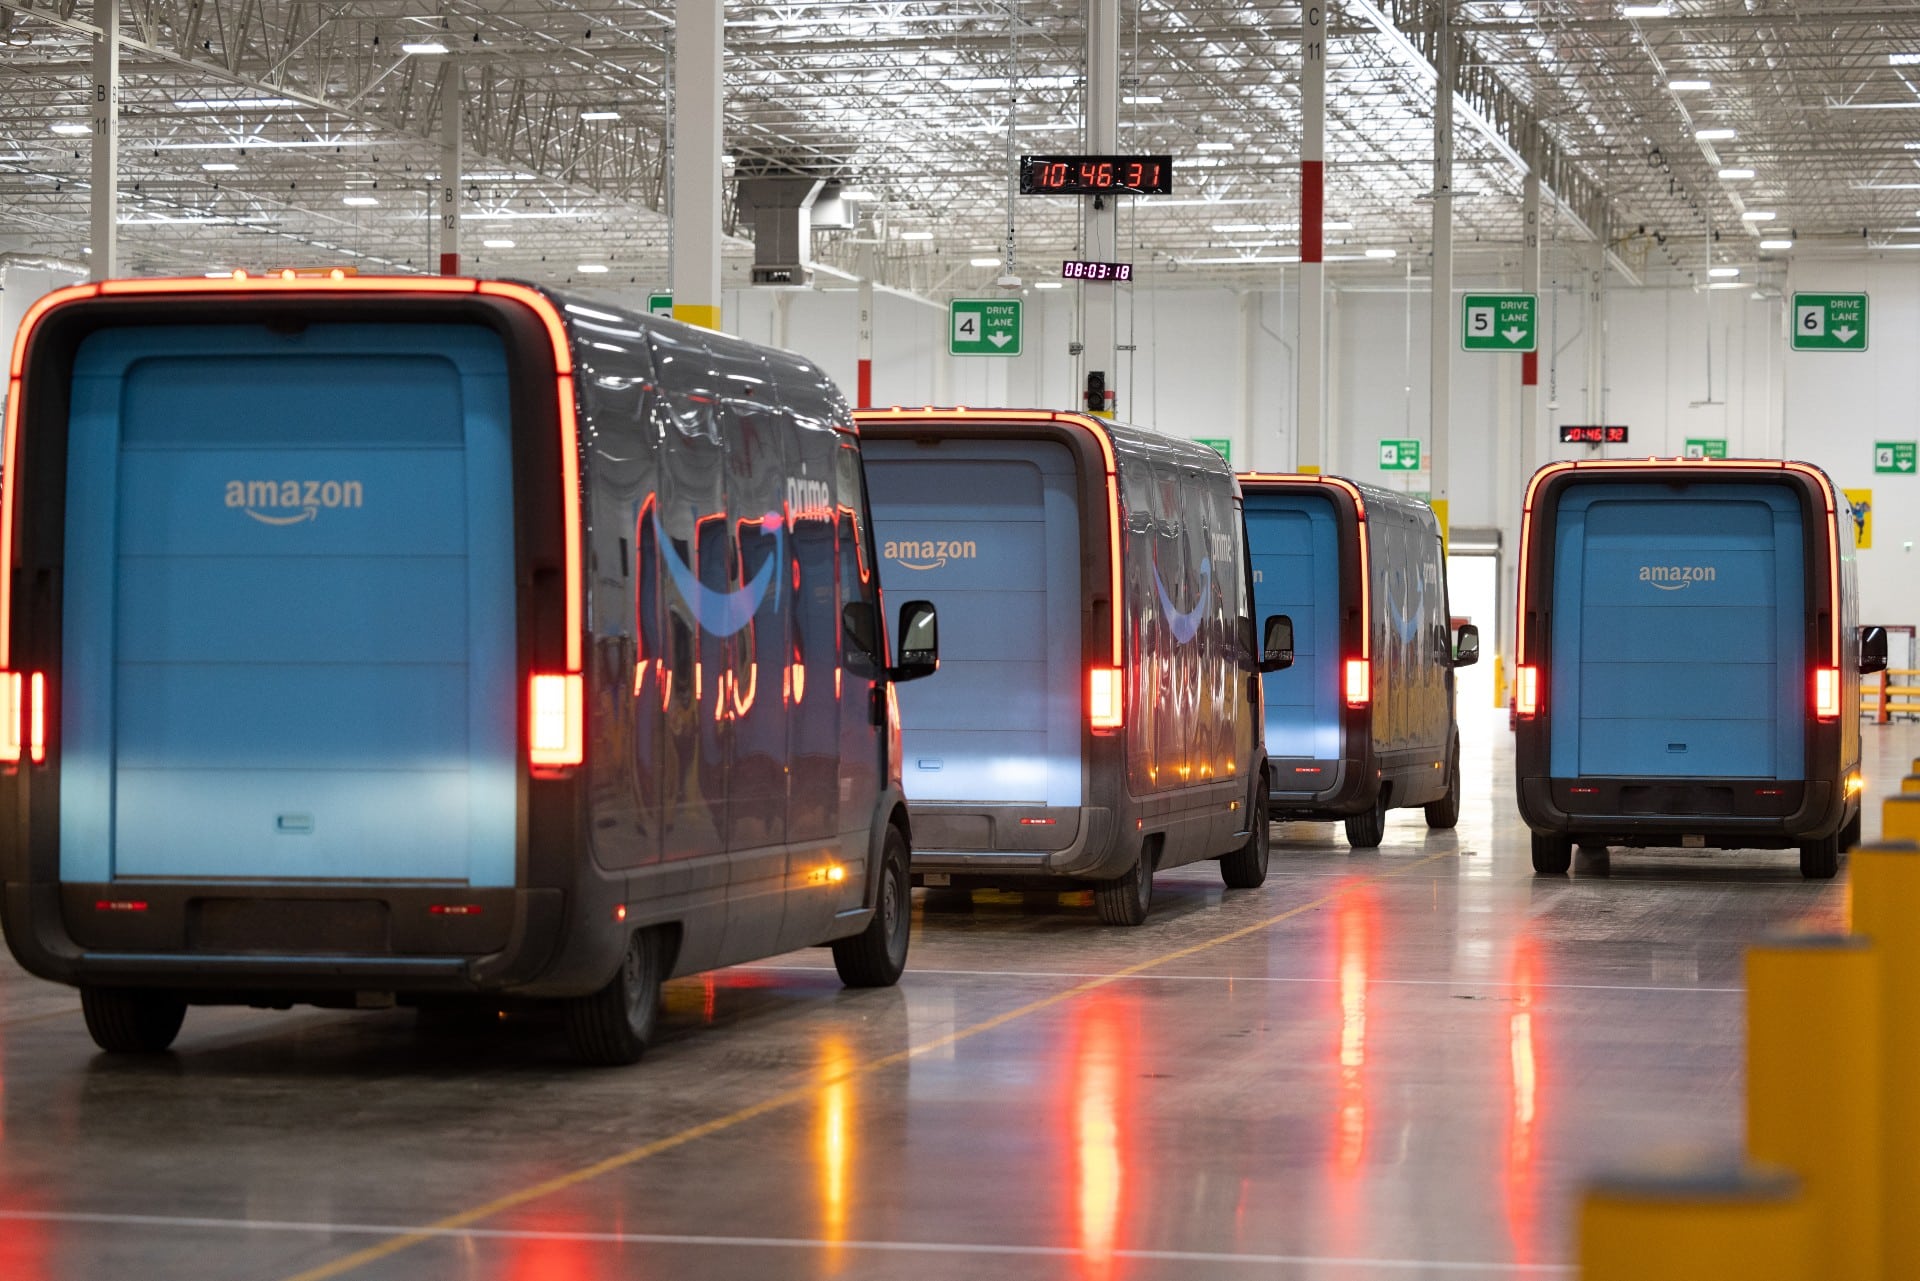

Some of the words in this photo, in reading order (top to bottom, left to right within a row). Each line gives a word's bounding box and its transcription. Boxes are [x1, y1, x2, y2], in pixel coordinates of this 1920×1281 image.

[1309, 7, 1320, 26] C
[1307, 42, 1320, 60] 11
[97, 84, 106, 102] B
[95, 117, 106, 135] 11
[1041, 163, 1161, 188] 10:46:31
[445, 187, 453, 202] B
[443, 214, 455, 229] 12
[1064, 262, 1130, 280] 08:03:18
[986, 306, 1014, 315] DRIVE
[1500, 301, 1530, 310] DRIVE
[1830, 300, 1860, 309] DRIVE
[987, 318, 1014, 327] LANE
[1474, 313, 1488, 331] 5
[1501, 313, 1529, 322] LANE
[1803, 311, 1818, 330] 6
[1831, 312, 1859, 321] LANE
[959, 317, 975, 336] 4
[1384, 449, 1393, 460] 4
[1880, 451, 1889, 464] 6
[224, 479, 364, 508] amazon
[787, 461, 831, 535] prime
[883, 540, 977, 560] amazon
[1211, 522, 1232, 572] prime
[1639, 566, 1716, 582] amazon
